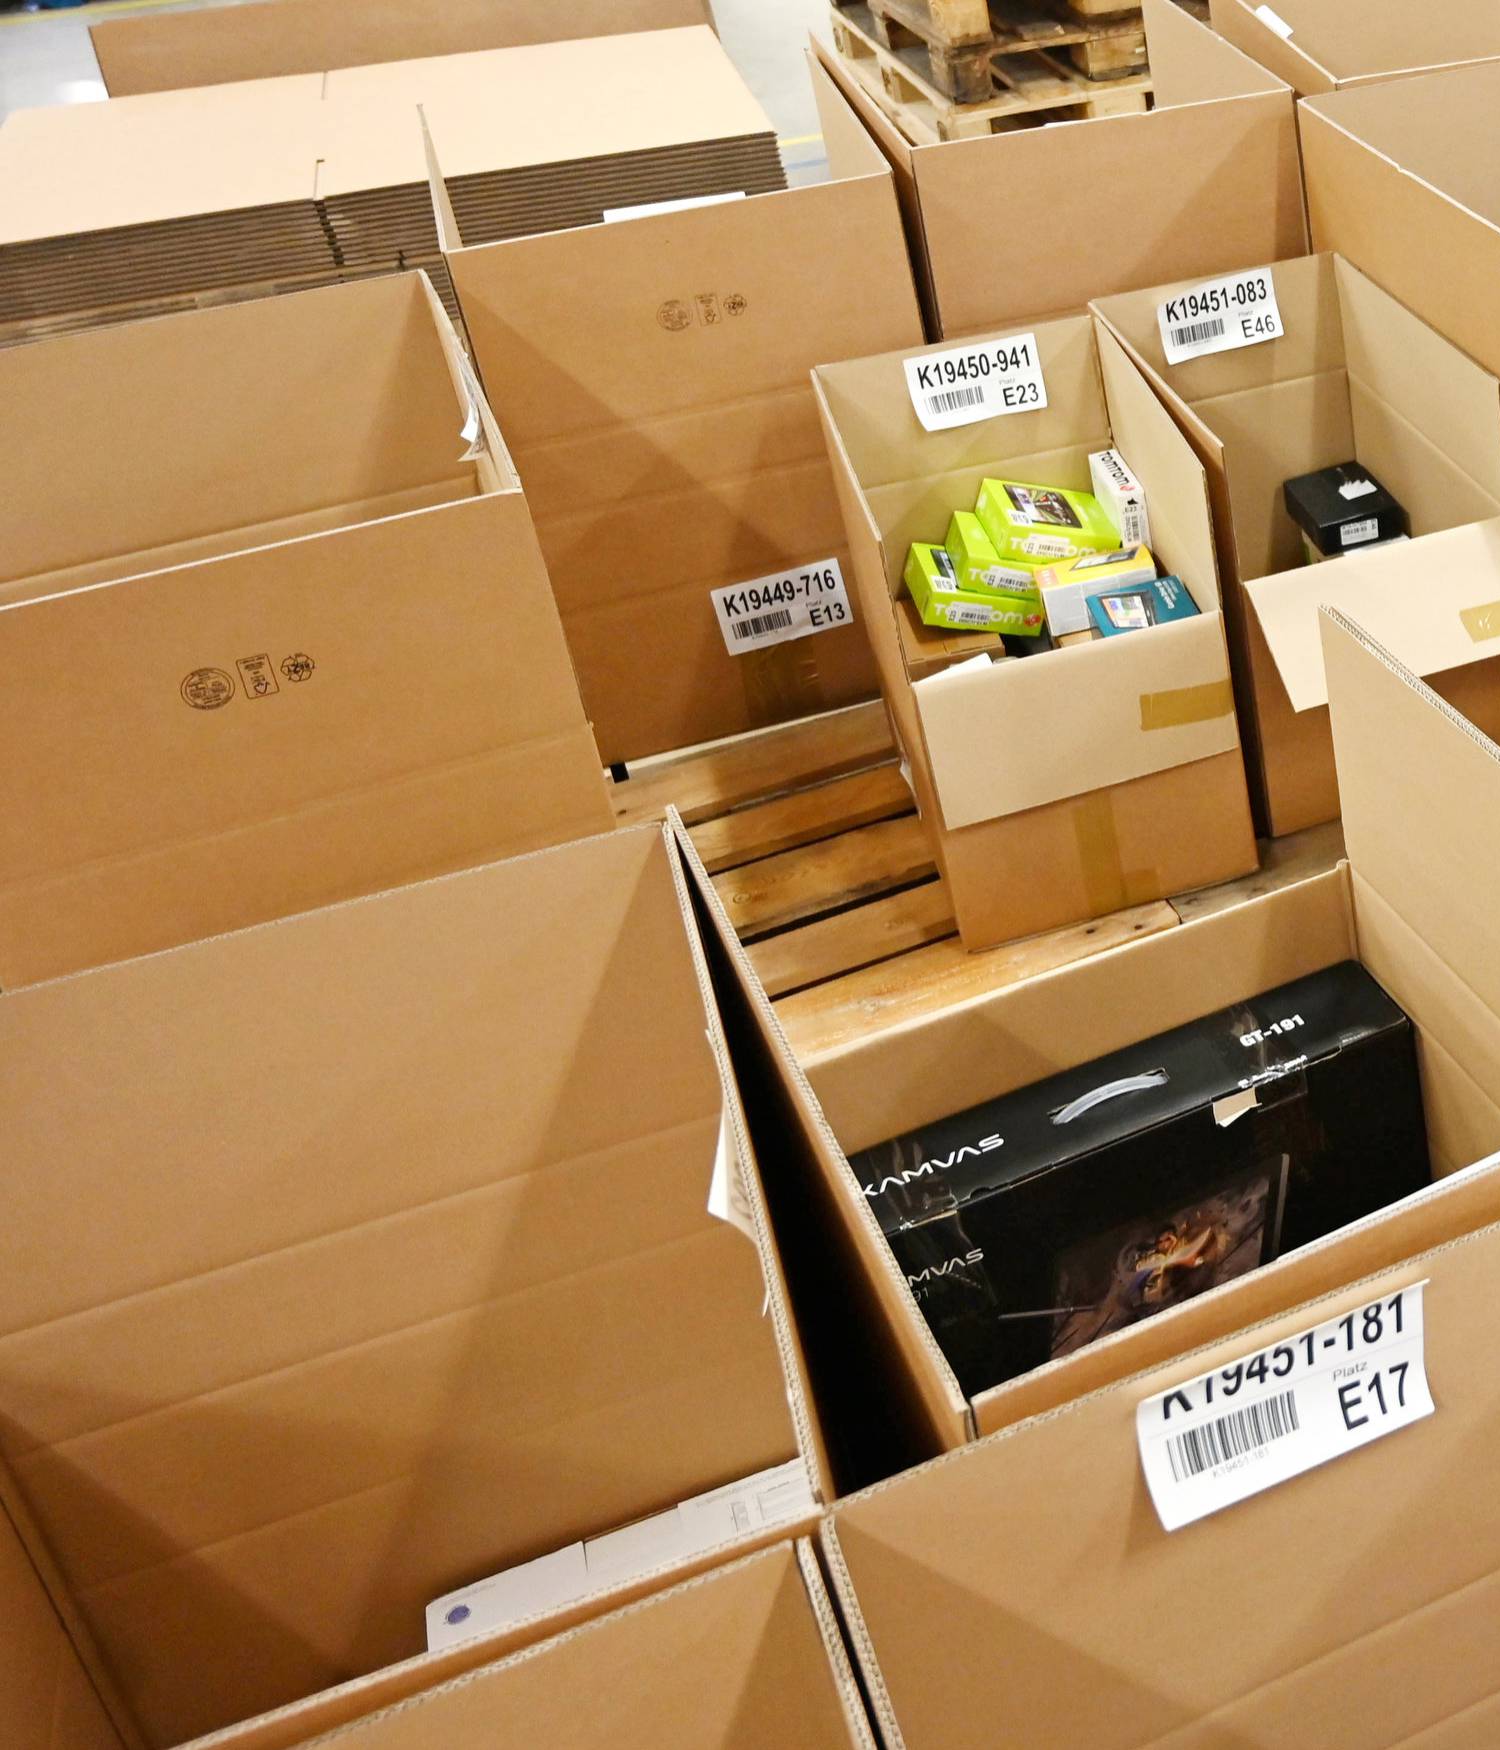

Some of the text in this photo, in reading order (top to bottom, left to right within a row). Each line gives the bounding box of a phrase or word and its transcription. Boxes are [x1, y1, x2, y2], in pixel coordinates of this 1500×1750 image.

[1165, 278, 1267, 323] K19451-083
[1241, 314, 1276, 338] E46
[917, 344, 1031, 390] K19450-941
[1002, 382, 1039, 407] E23
[723, 569, 836, 618] K19449-716
[809, 603, 845, 627] E13
[1240, 1014, 1305, 1047] GT-191
[907, 1248, 984, 1287] MVAS
[1333, 1360, 1368, 1381] Platz
[1337, 1361, 1409, 1431] E17
